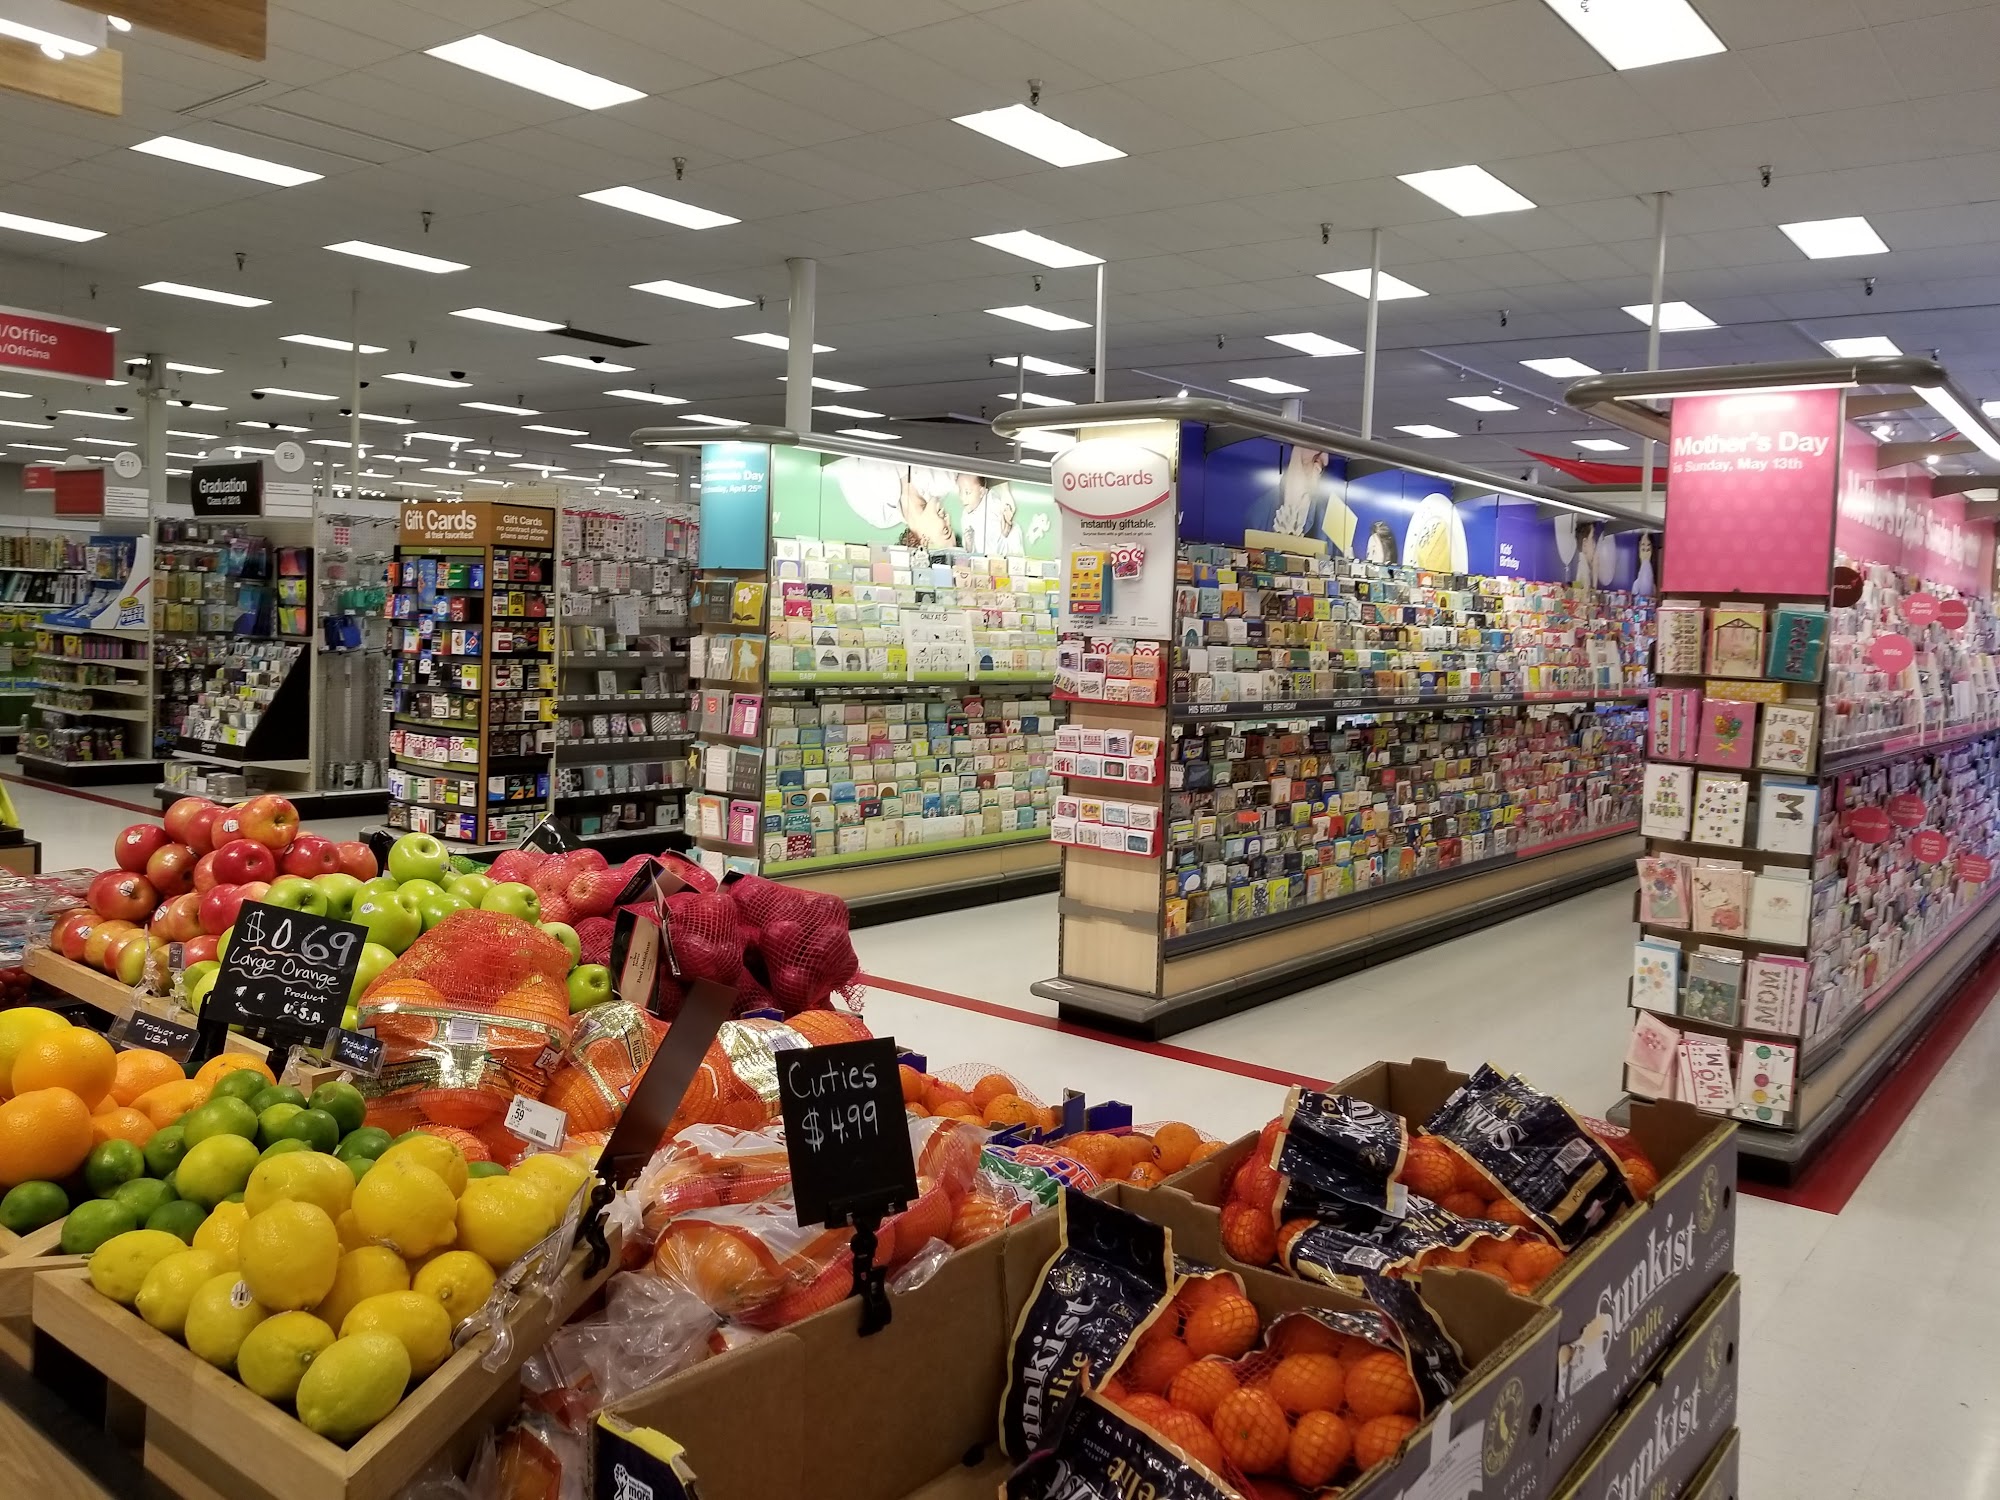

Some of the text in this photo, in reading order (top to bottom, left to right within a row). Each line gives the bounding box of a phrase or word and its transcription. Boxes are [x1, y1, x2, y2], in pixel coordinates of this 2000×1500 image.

[1673, 430, 1830, 457] Mother's Day
[1673, 457, 1803, 473] is Sunday, May 13th
[199, 478, 247, 493] Graduation
[743, 470, 764, 482] Day
[1077, 470, 1153, 488] GiftCards
[405, 509, 477, 531] Gift Cards
[503, 515, 543, 526] Gift Cards
[1080, 519, 1156, 531] instantly giftable.
[1188, 704, 1228, 714] HIS BIRTHDAY
[1272, 702, 1297, 711] BIRTHDAY
[229, 946, 339, 989] Large Orange
[284, 986, 327, 1003] Product
[284, 1003, 325, 1023] U.S.A.
[136, 1018, 188, 1041] Product of
[144, 1032, 169, 1046] USA
[341, 1037, 368, 1052] Product
[788, 1058, 877, 1098] Cuties
[1701, 1051, 1725, 1099] MOM
[1630, 1305, 1664, 1358] Delite
[1022, 1296, 1098, 1451] unkist
[1049, 1351, 1089, 1414] elite
[1083, 1437, 1110, 1459] SEEDLESS
[1107, 1455, 1157, 1500] elite
